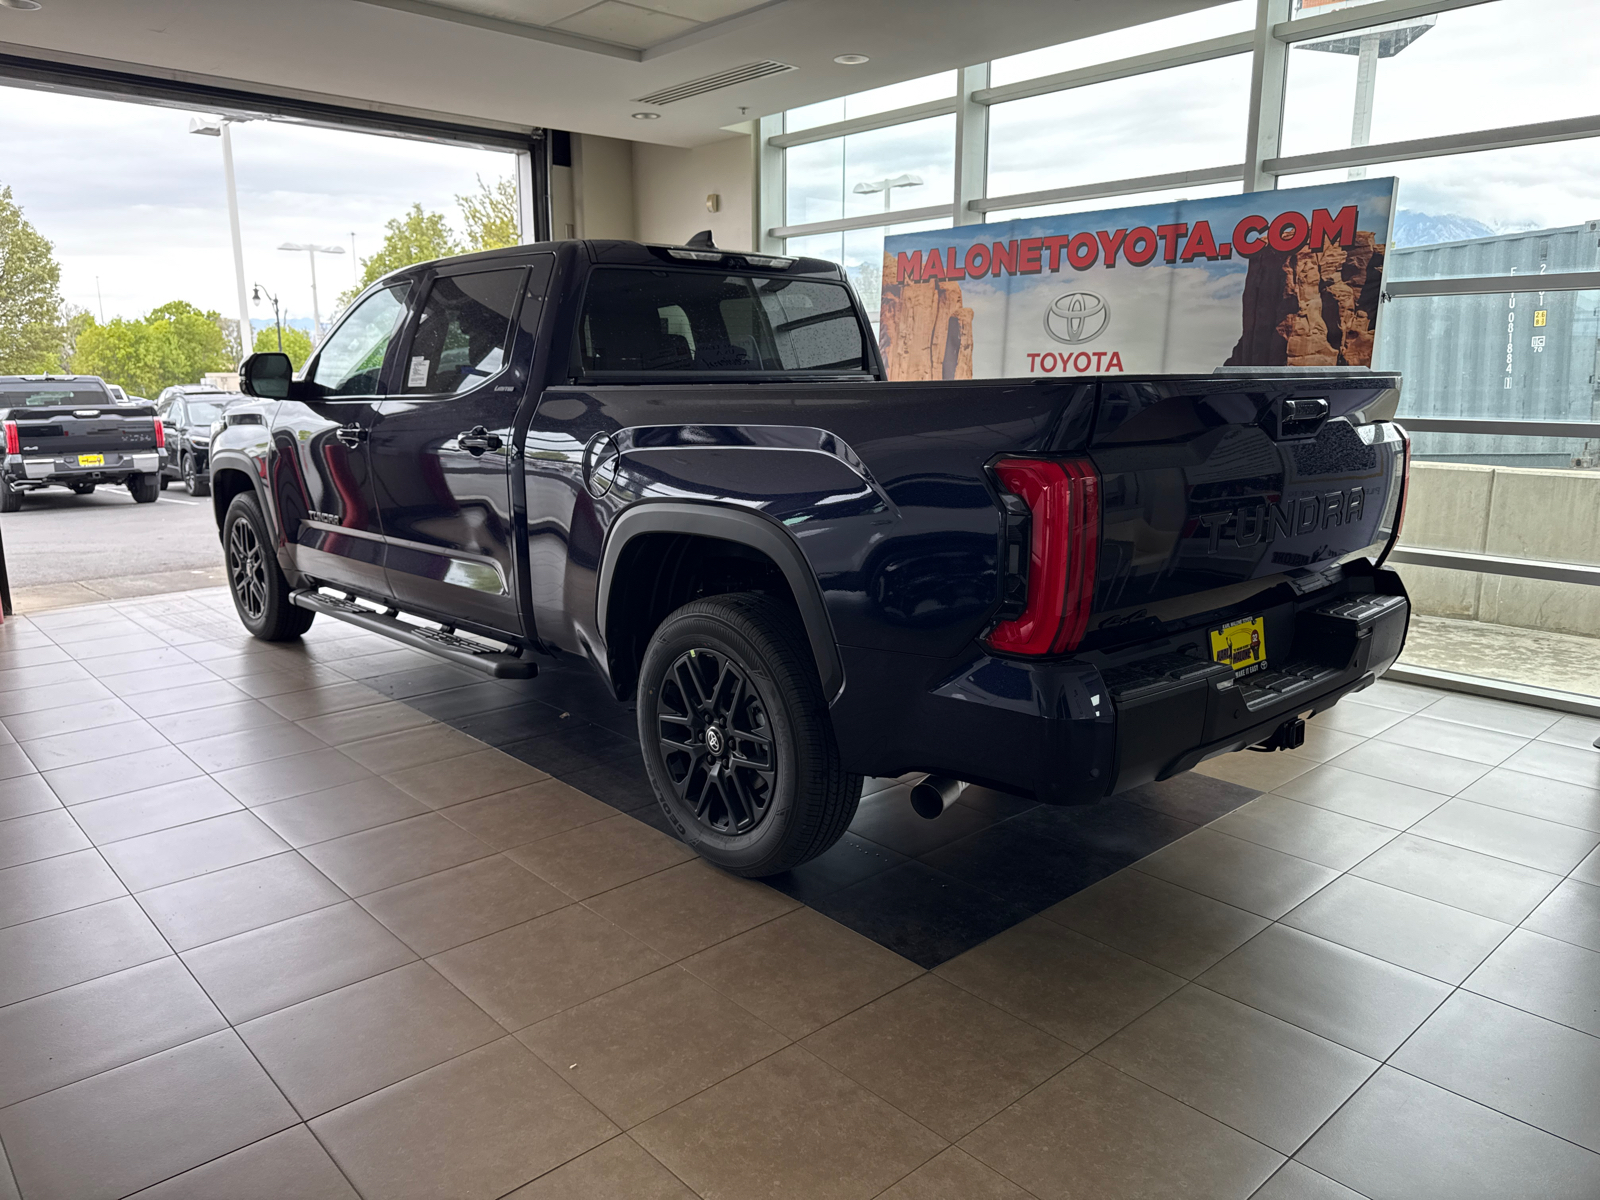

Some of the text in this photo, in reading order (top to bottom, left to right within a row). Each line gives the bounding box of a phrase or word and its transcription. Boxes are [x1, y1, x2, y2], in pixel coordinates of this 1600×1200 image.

[896, 204, 1359, 285] MALONETOYOTA.COM
[1508, 266, 1517, 309] FU
[1538, 263, 1547, 306] 21
[1026, 351, 1124, 373] TOYOTA
[308, 510, 340, 526] TUNDRA
[1199, 486, 1366, 555] TUNDRA
[1250, 665, 1258, 673] EASY
